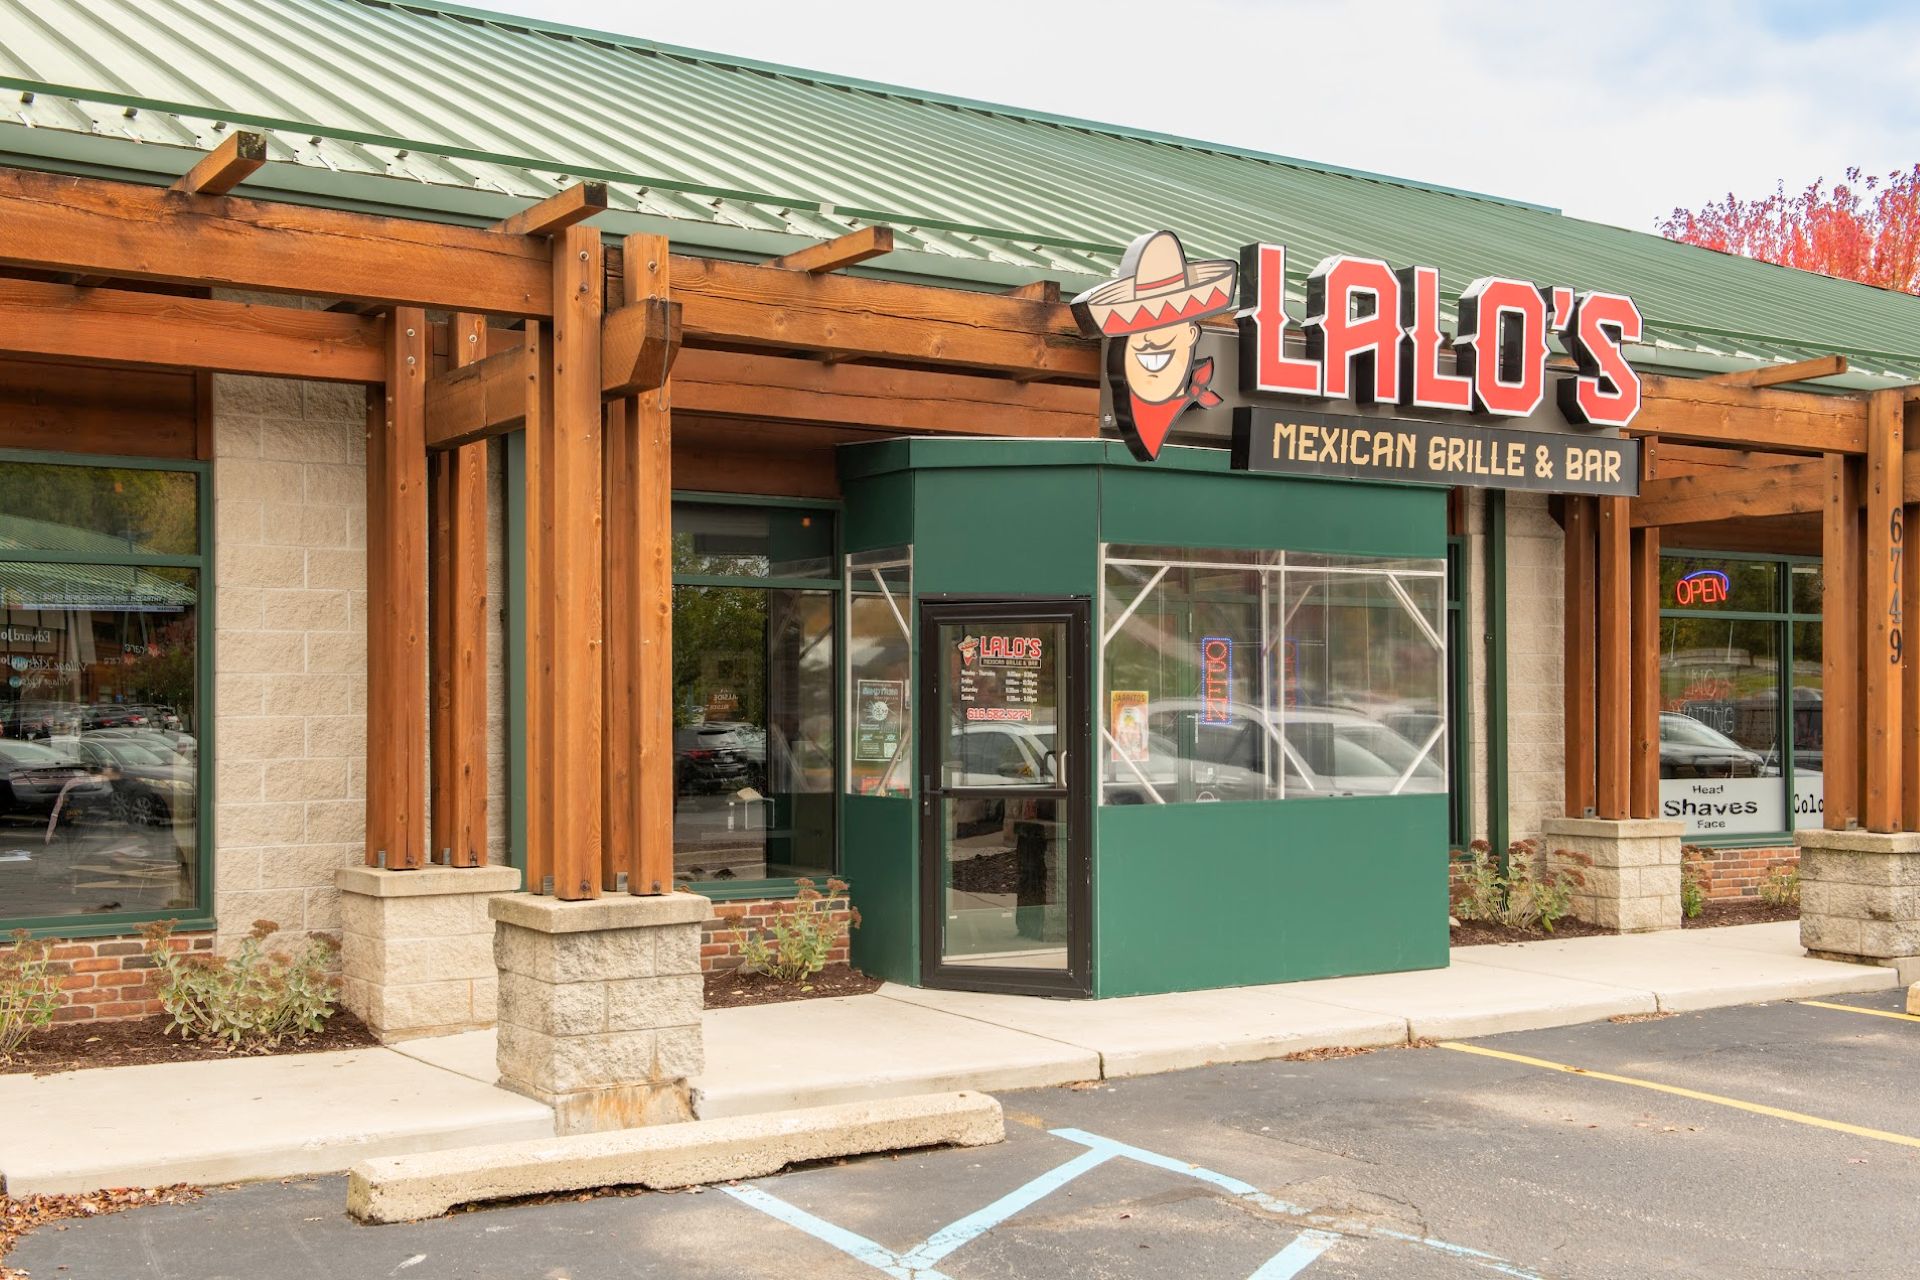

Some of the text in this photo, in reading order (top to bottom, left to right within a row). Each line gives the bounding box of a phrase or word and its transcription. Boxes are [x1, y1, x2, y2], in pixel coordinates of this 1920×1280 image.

[1254, 241, 1643, 428] LALO'S
[1272, 421, 1622, 483] MEXICAN GRILLE & BAR
[1676, 575, 1728, 606] OPEN
[1889, 506, 1904, 665] 6749
[980, 636, 1041, 658] LALO'S
[1205, 640, 1228, 722] OPEN
[1692, 784, 1724, 795] Head
[1663, 798, 1758, 818] Shaves
[1697, 819, 1726, 829] Face
